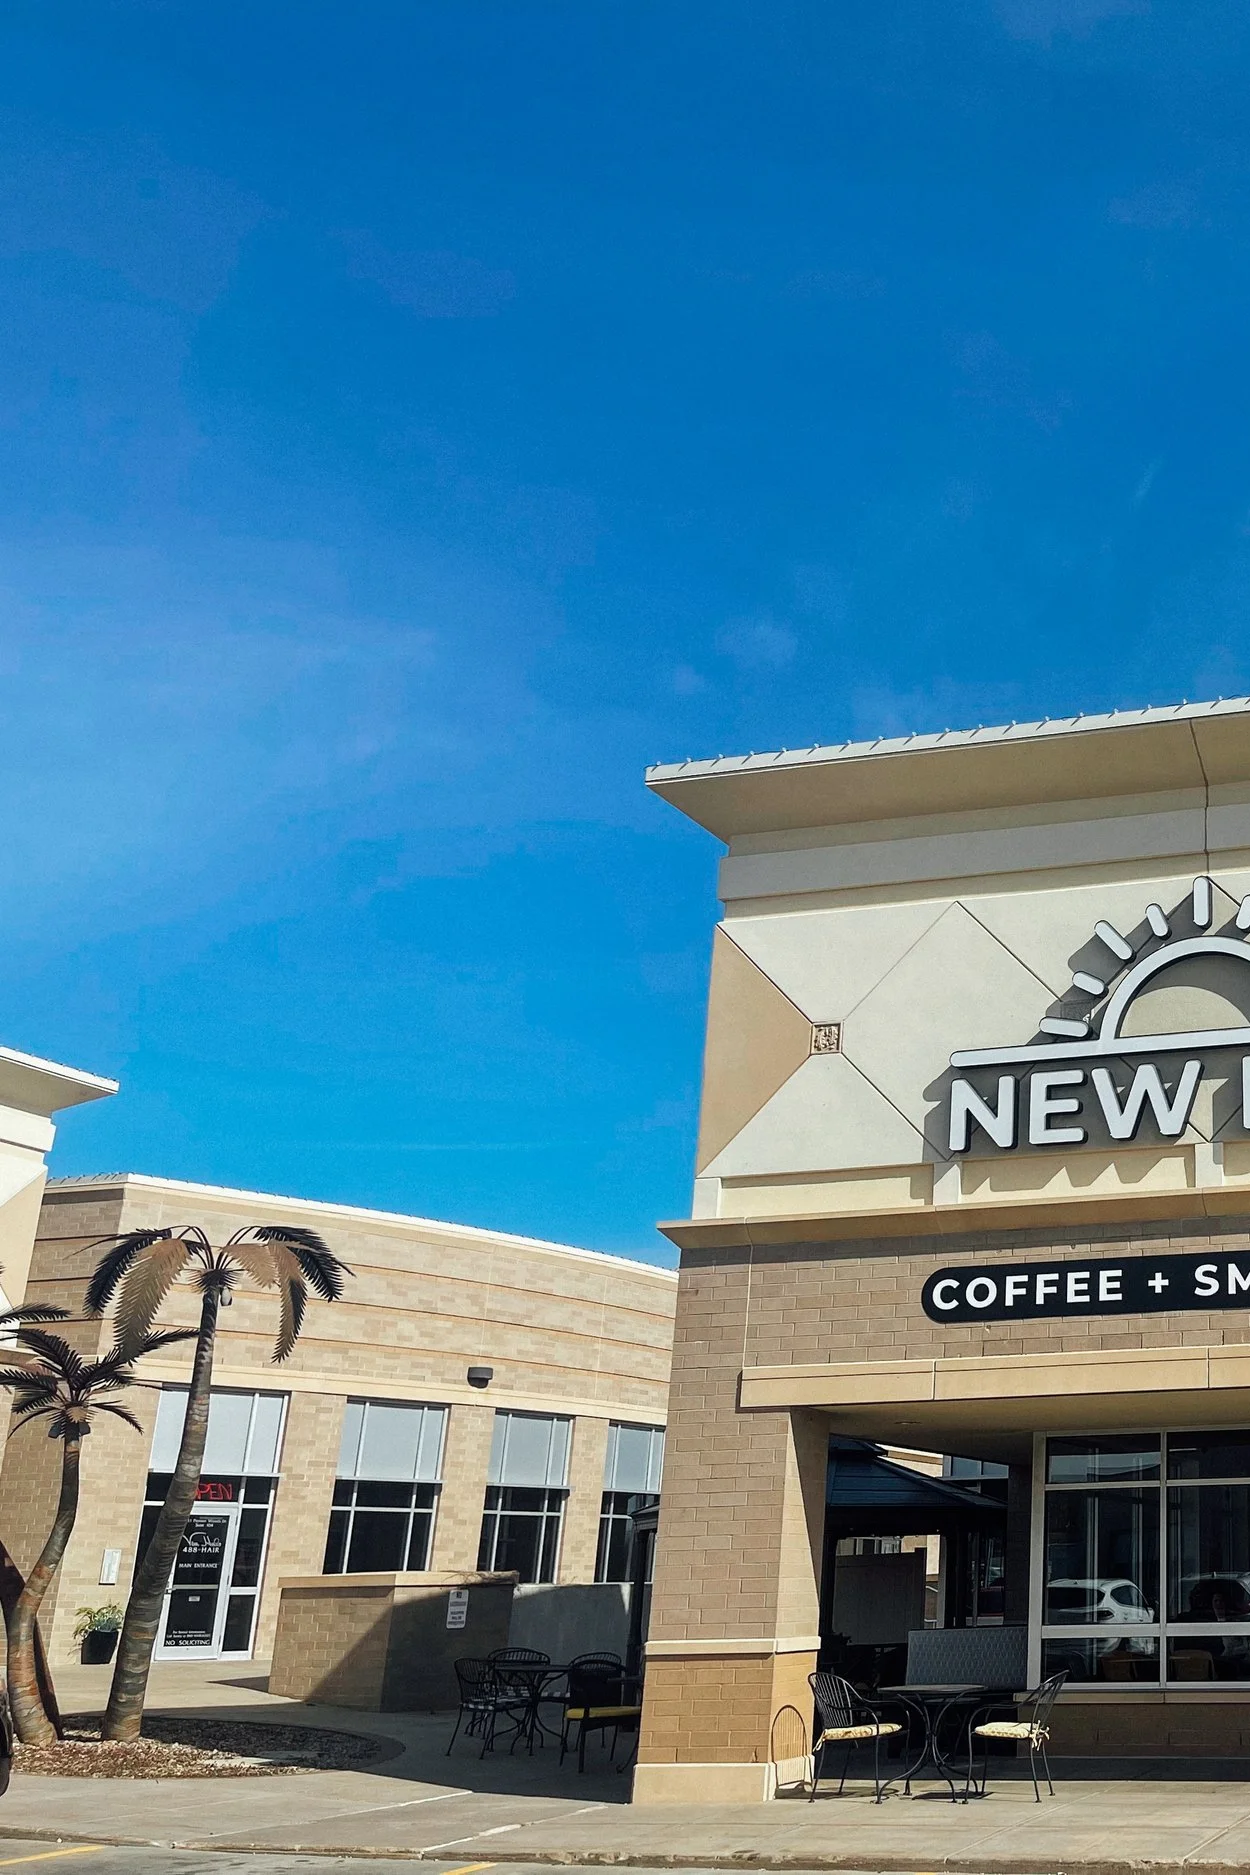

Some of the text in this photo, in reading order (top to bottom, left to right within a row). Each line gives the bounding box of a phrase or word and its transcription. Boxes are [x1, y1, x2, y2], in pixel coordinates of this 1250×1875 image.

[949, 1060, 1204, 1152] NEW
[932, 1269, 1123, 1310] COFFEE
[195, 1483, 233, 1500] PEN
